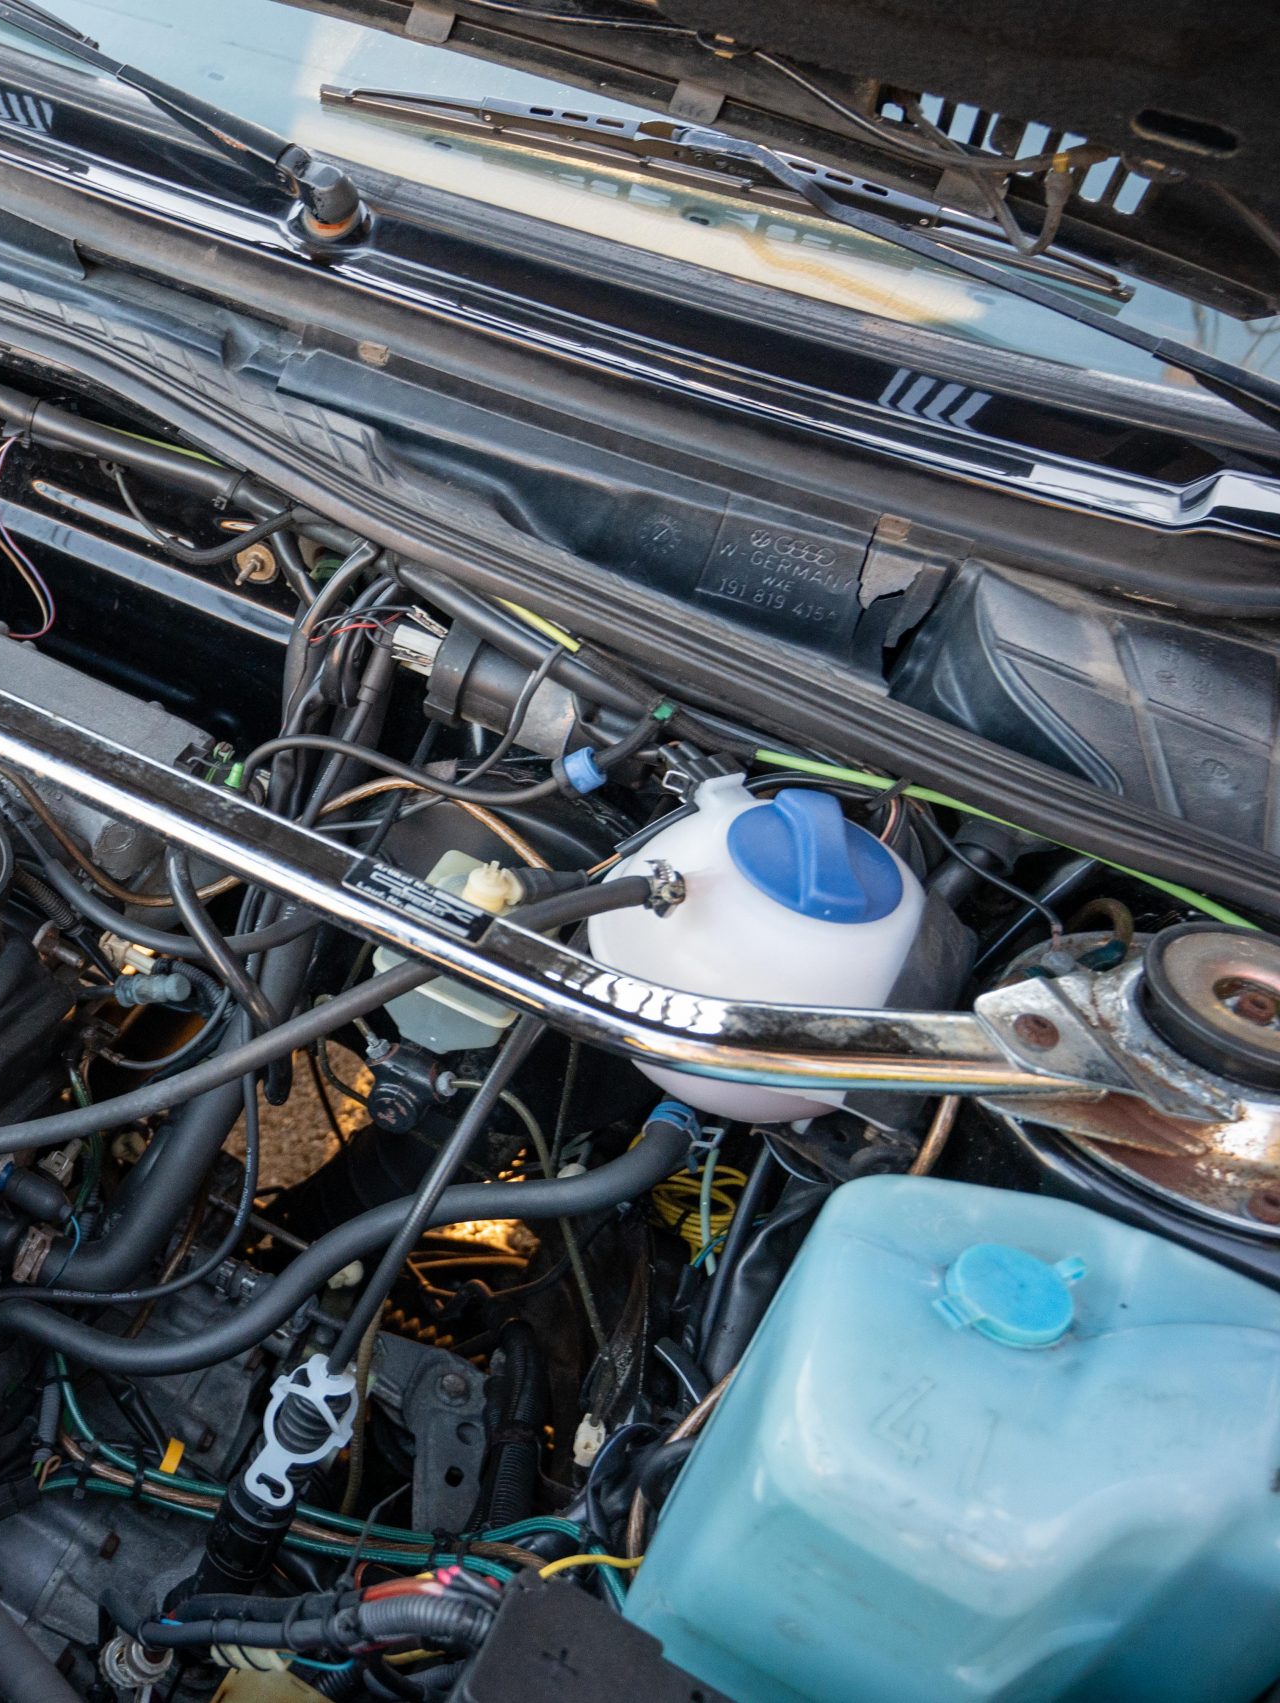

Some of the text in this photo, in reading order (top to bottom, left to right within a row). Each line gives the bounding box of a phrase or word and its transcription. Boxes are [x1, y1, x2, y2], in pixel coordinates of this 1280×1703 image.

[719, 578, 747, 597] 191
[752, 588, 786, 609] 819
[373, 863, 414, 885] Artikel
